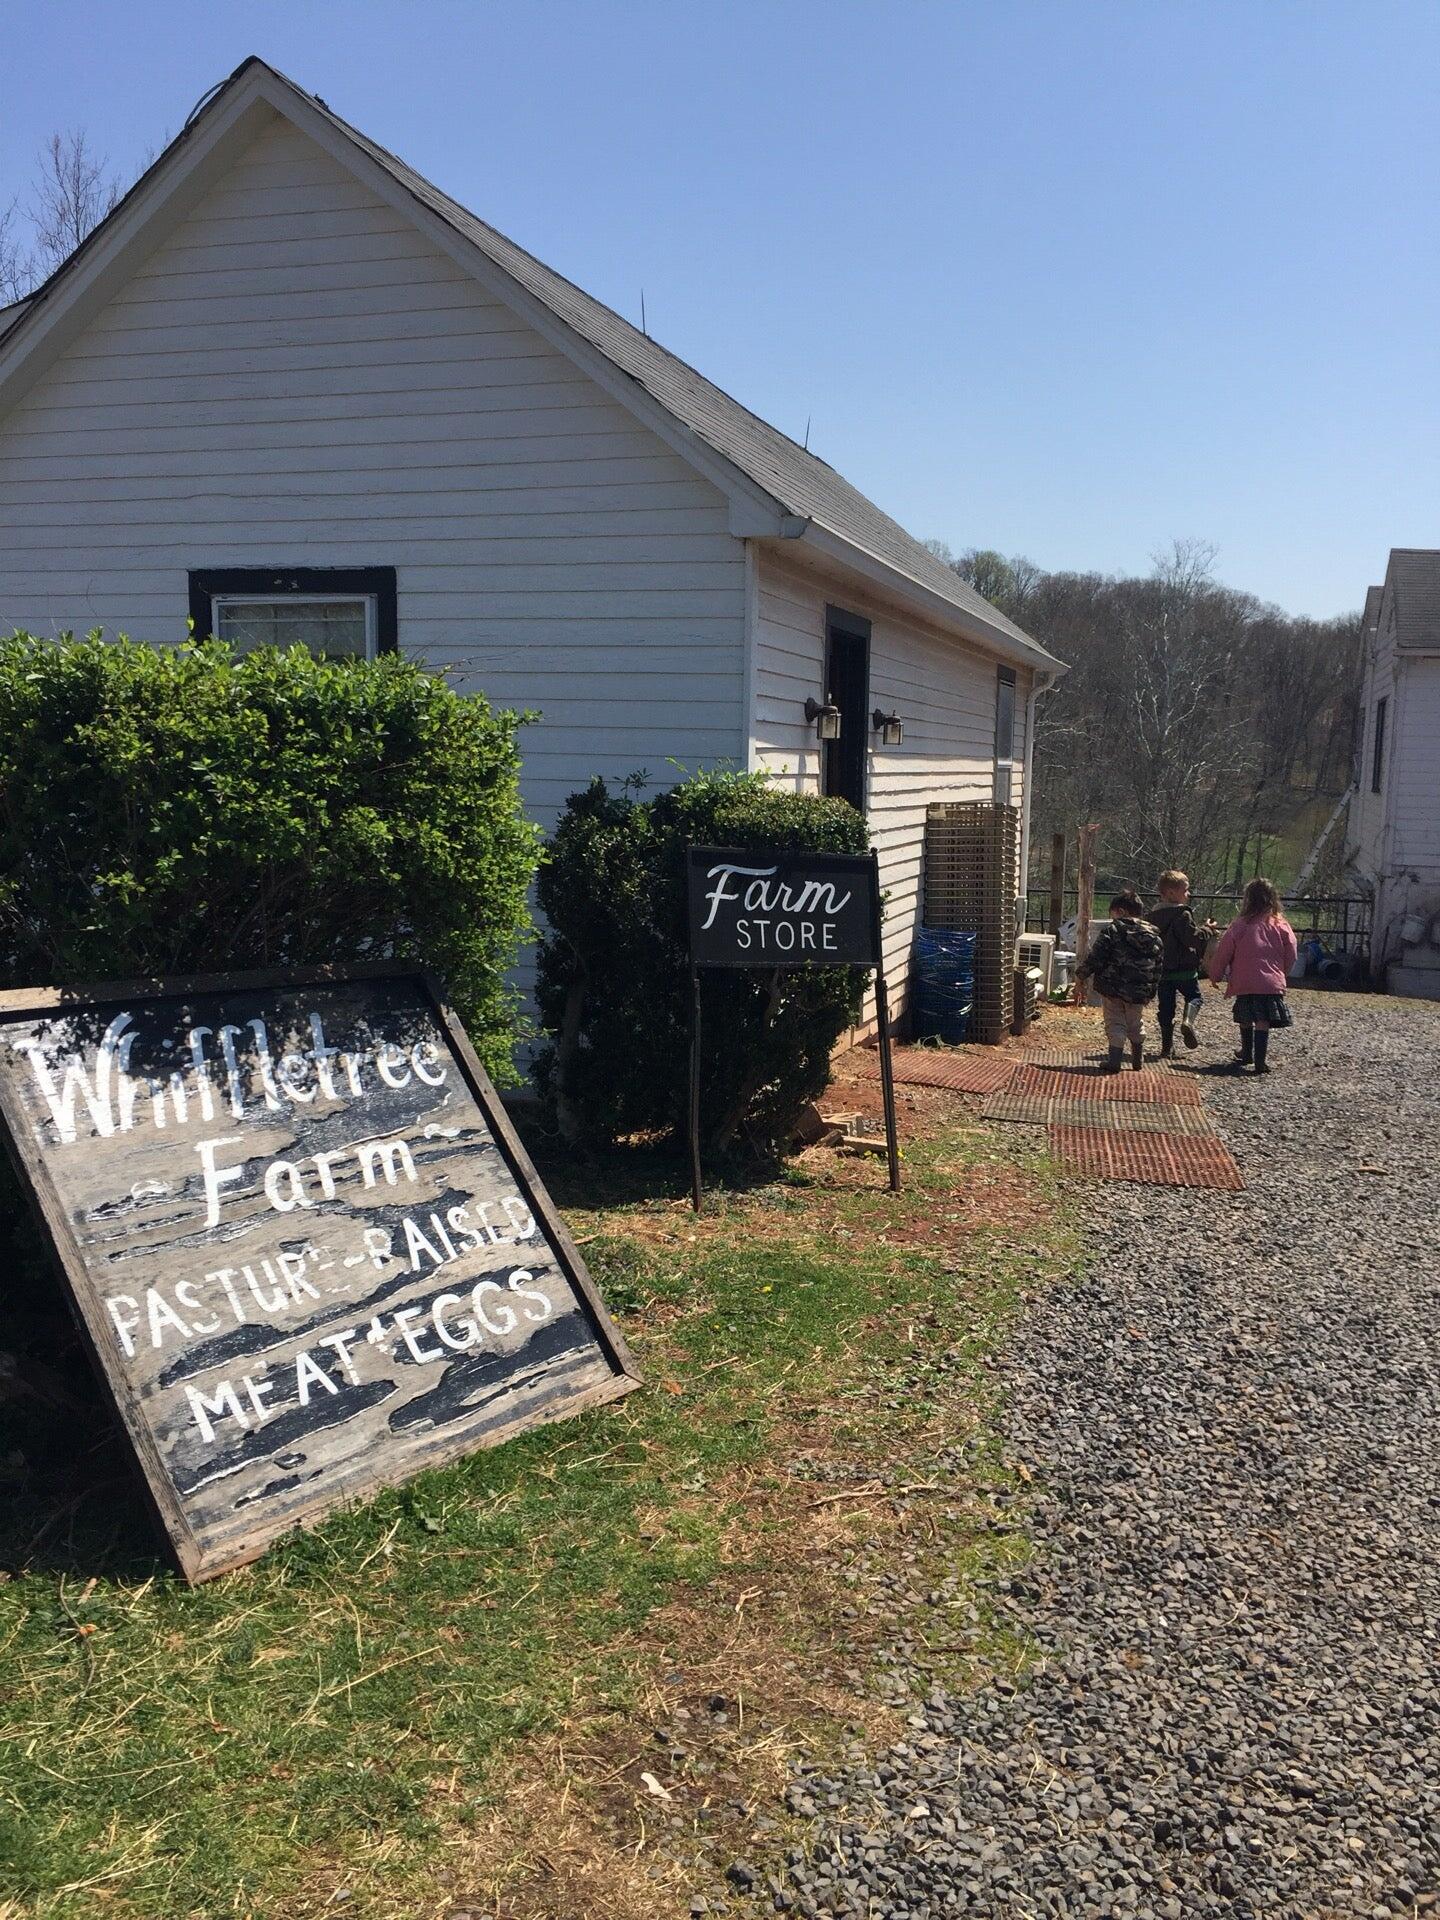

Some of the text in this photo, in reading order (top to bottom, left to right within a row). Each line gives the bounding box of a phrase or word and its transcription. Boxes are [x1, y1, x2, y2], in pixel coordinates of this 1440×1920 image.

[700, 863, 851, 930] Farm
[736, 919, 838, 950] STORE
[13, 1012, 448, 1144] Whiffletree
[194, 1136, 419, 1228] Farm
[393, 1270, 552, 1364] EGGS
